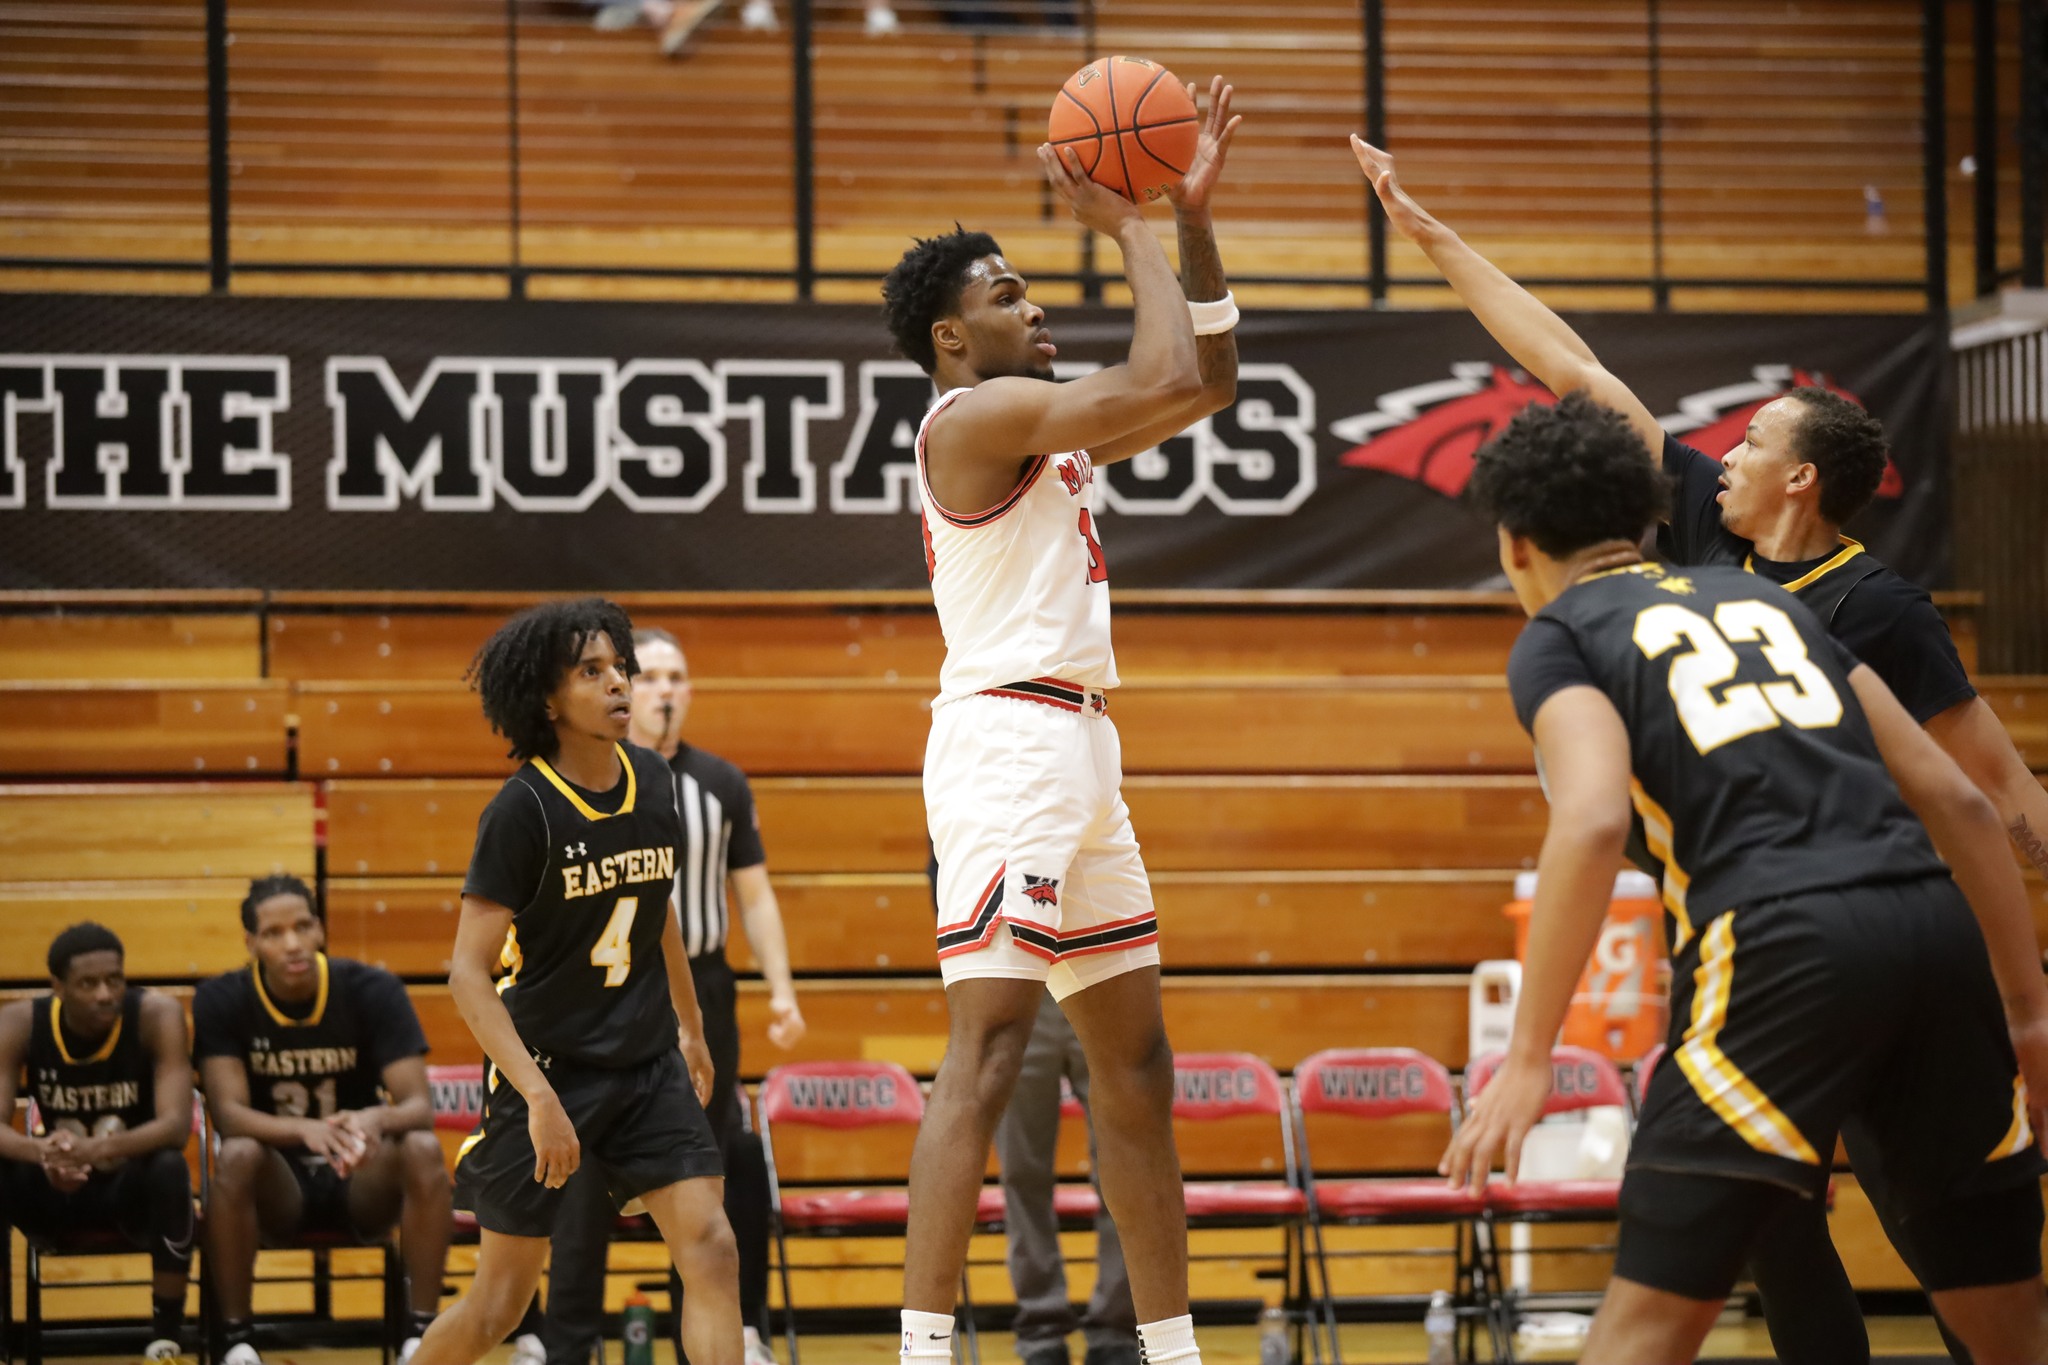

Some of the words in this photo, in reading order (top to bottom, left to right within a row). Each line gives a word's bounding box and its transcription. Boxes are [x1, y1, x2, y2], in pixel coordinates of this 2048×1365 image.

[1632, 599, 1844, 757] 23
[562, 846, 675, 900] EASTERN
[590, 896, 639, 987] 4
[249, 1047, 357, 1076] EASTERN
[39, 1080, 139, 1112] EASTERN
[785, 1074, 894, 1112] WWCC
[1319, 1064, 1425, 1103] WWCC
